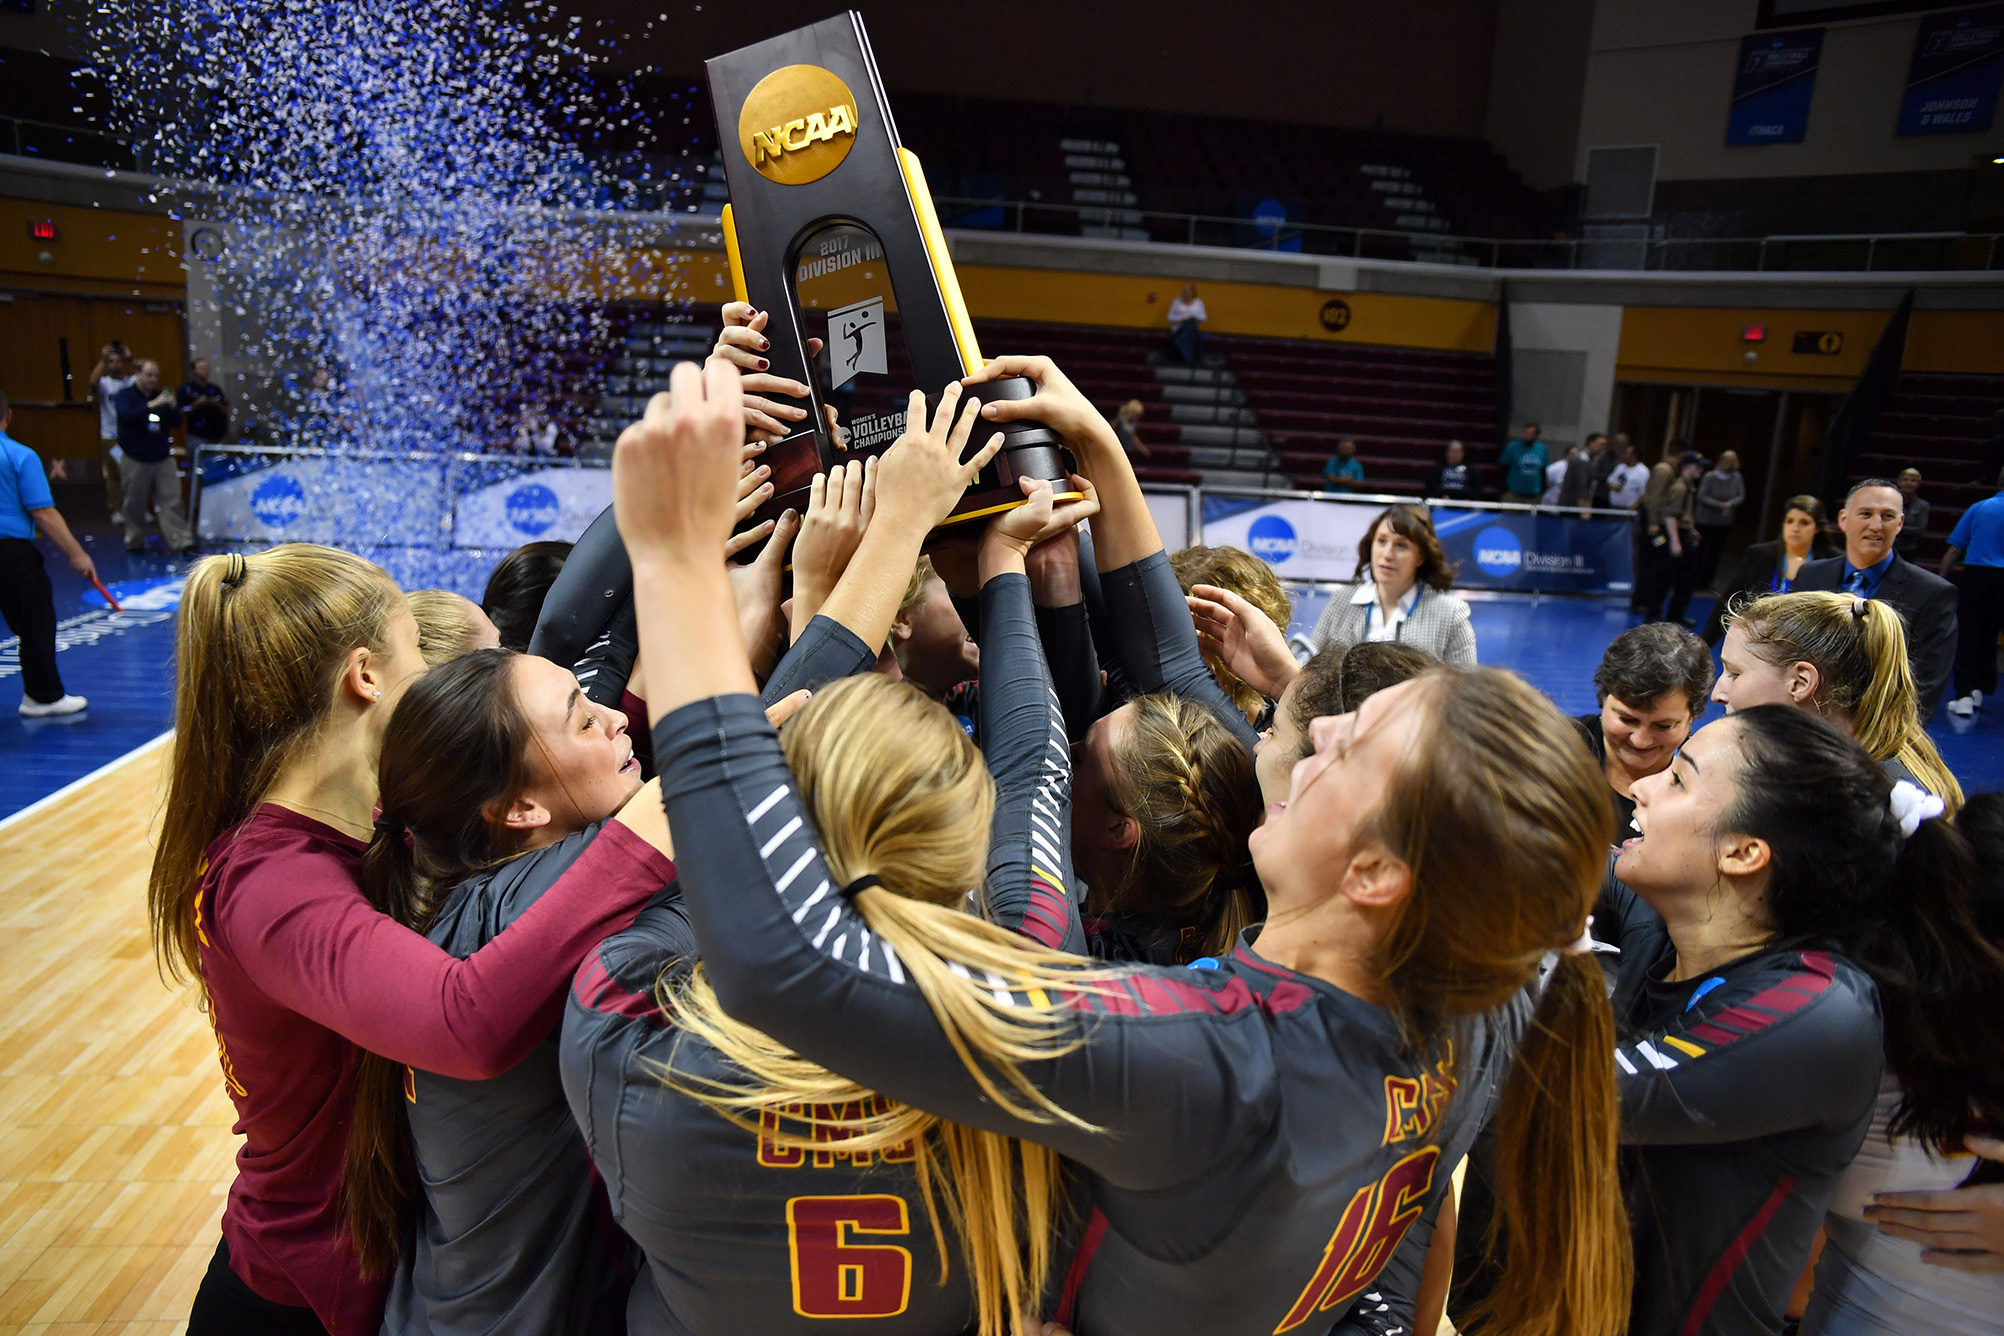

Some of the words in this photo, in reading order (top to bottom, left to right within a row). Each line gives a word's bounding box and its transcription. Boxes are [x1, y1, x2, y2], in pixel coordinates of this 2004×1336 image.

[1920, 98, 1979, 112] JOHNSON
[1932, 111, 1971, 124] WALES
[752, 103, 858, 168] NCAA
[820, 235, 850, 257] 2017
[798, 248, 862, 283] DIVISION
[865, 242, 882, 262] III
[850, 413, 878, 426] WOMEN'S
[1251, 537, 1298, 553] NCAA
[1476, 549, 1522, 566] NCAA
[1523, 550, 1572, 567] Division
[1271, 1144, 1441, 1335] 16
[786, 1193, 913, 1319] 6
